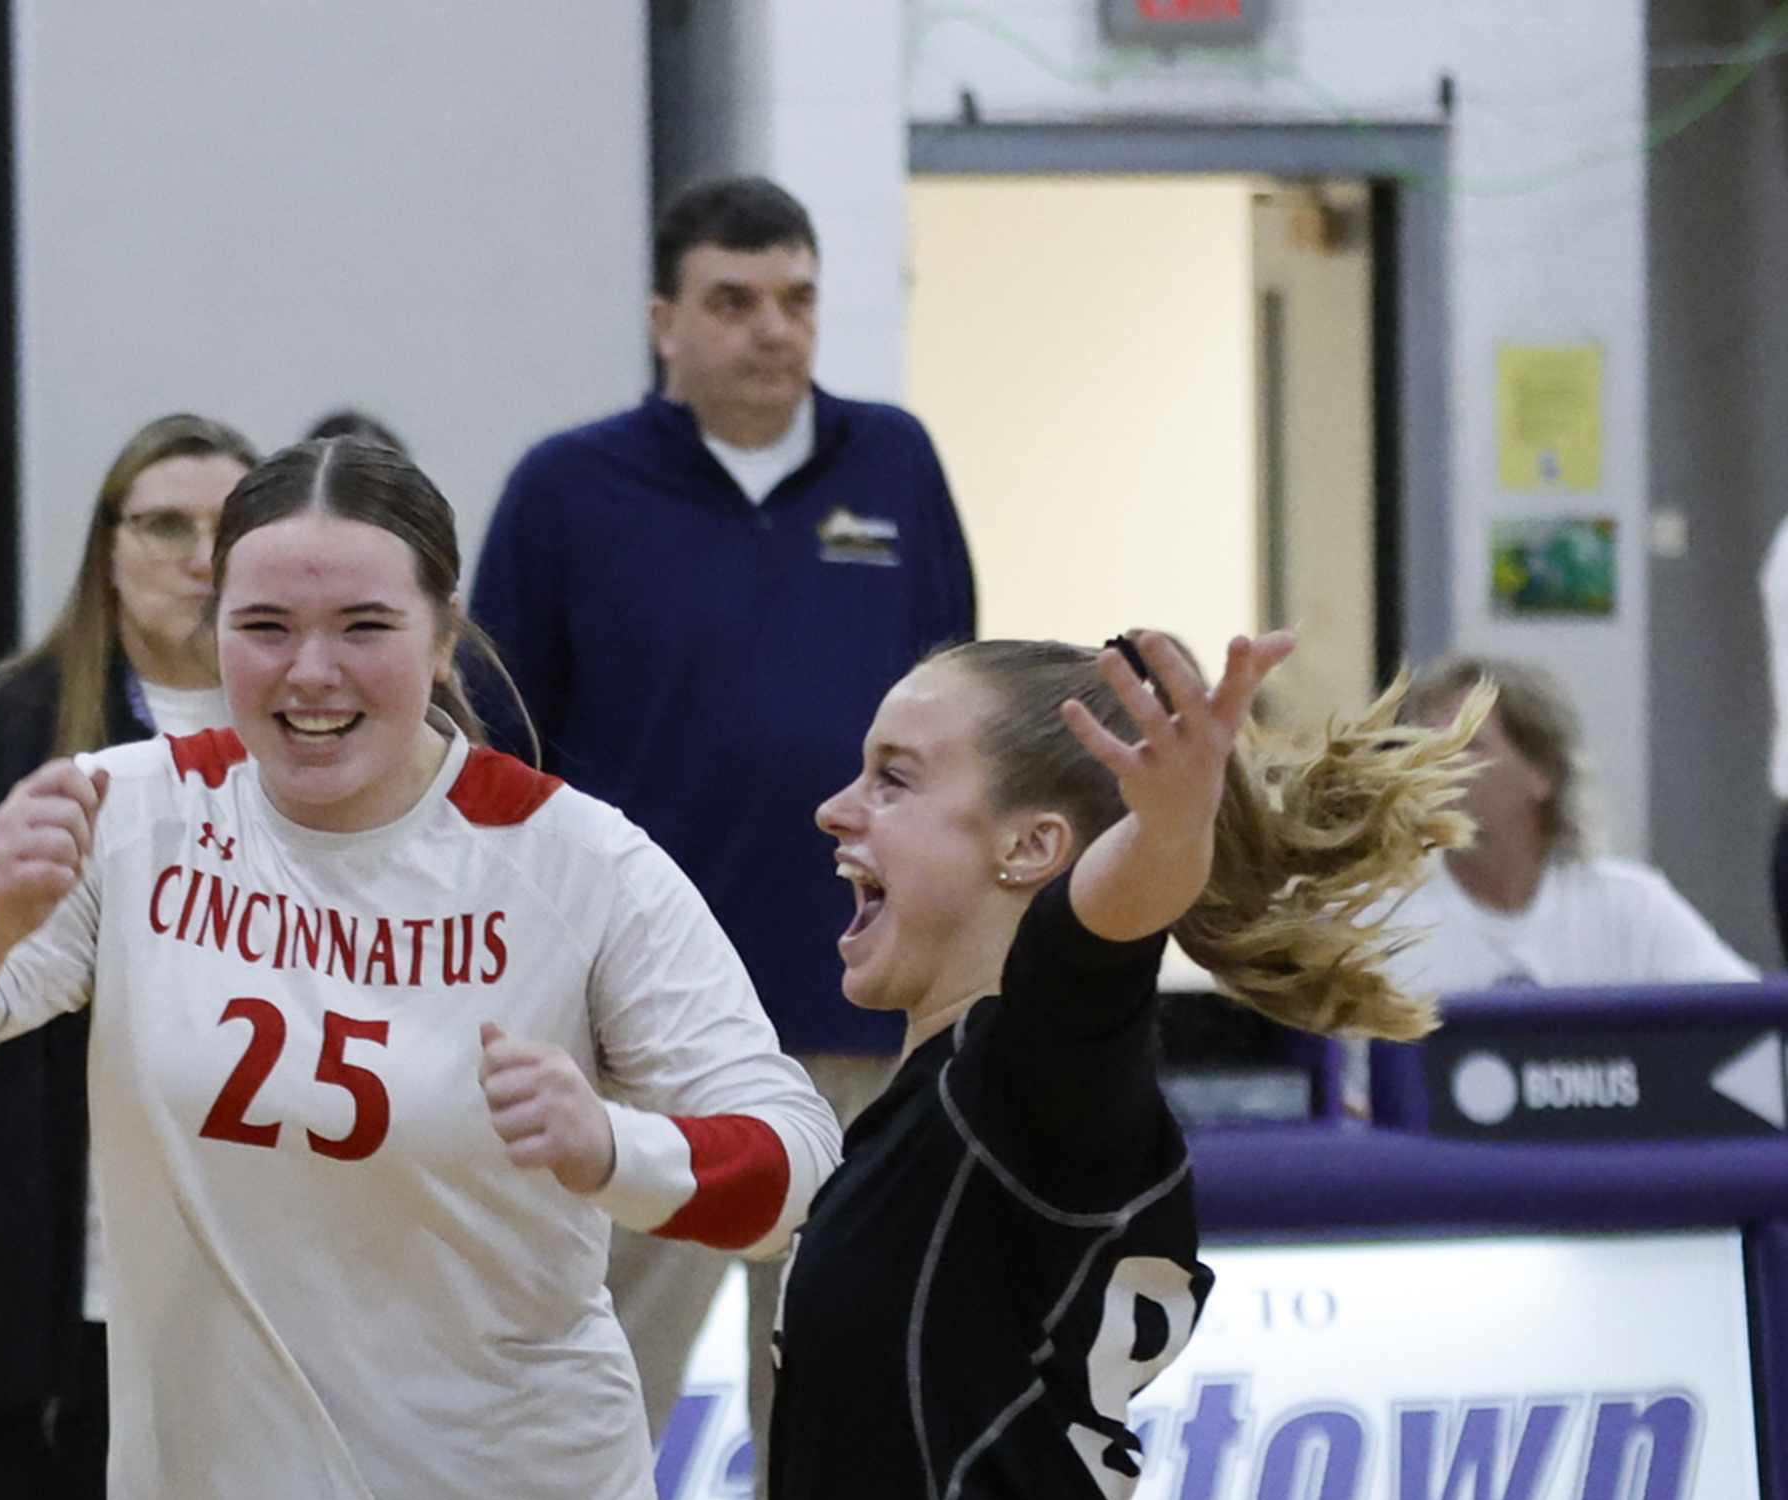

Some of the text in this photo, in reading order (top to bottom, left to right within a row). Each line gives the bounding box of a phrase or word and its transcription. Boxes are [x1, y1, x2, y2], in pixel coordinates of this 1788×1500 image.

[149, 864, 508, 986] CINCINNATUS
[198, 997, 391, 1162] 25
[1523, 1060, 1639, 1109] BONUS
[1249, 1284, 1340, 1333] TO
